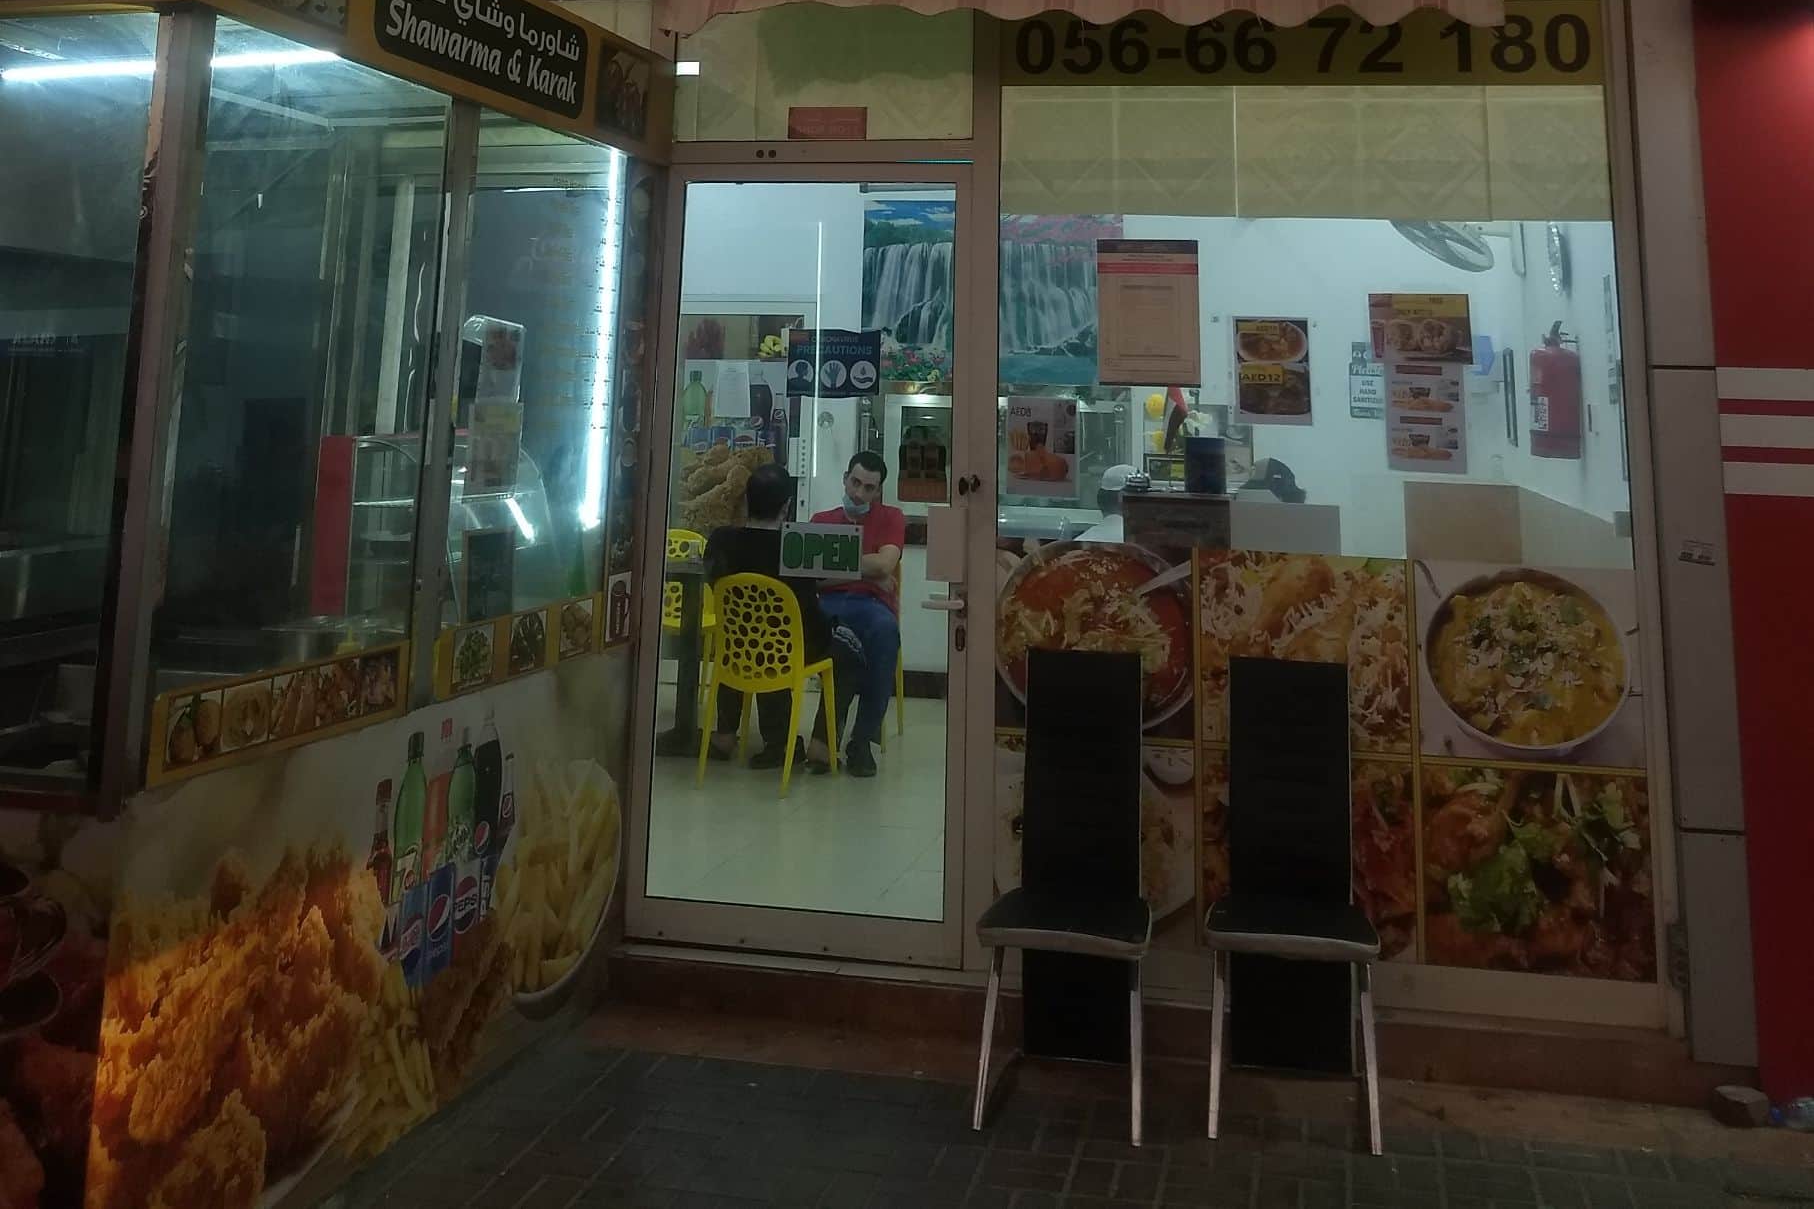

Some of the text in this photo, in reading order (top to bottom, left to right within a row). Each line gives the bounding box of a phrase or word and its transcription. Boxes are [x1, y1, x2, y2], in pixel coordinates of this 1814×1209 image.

[520, 12, 580, 61] شاورما
[1016, 14, 1590, 74] 056-66 72 180
[507, 49, 522, 84] &
[527, 55, 577, 104] Karak
[783, 532, 859, 572] OPEN
